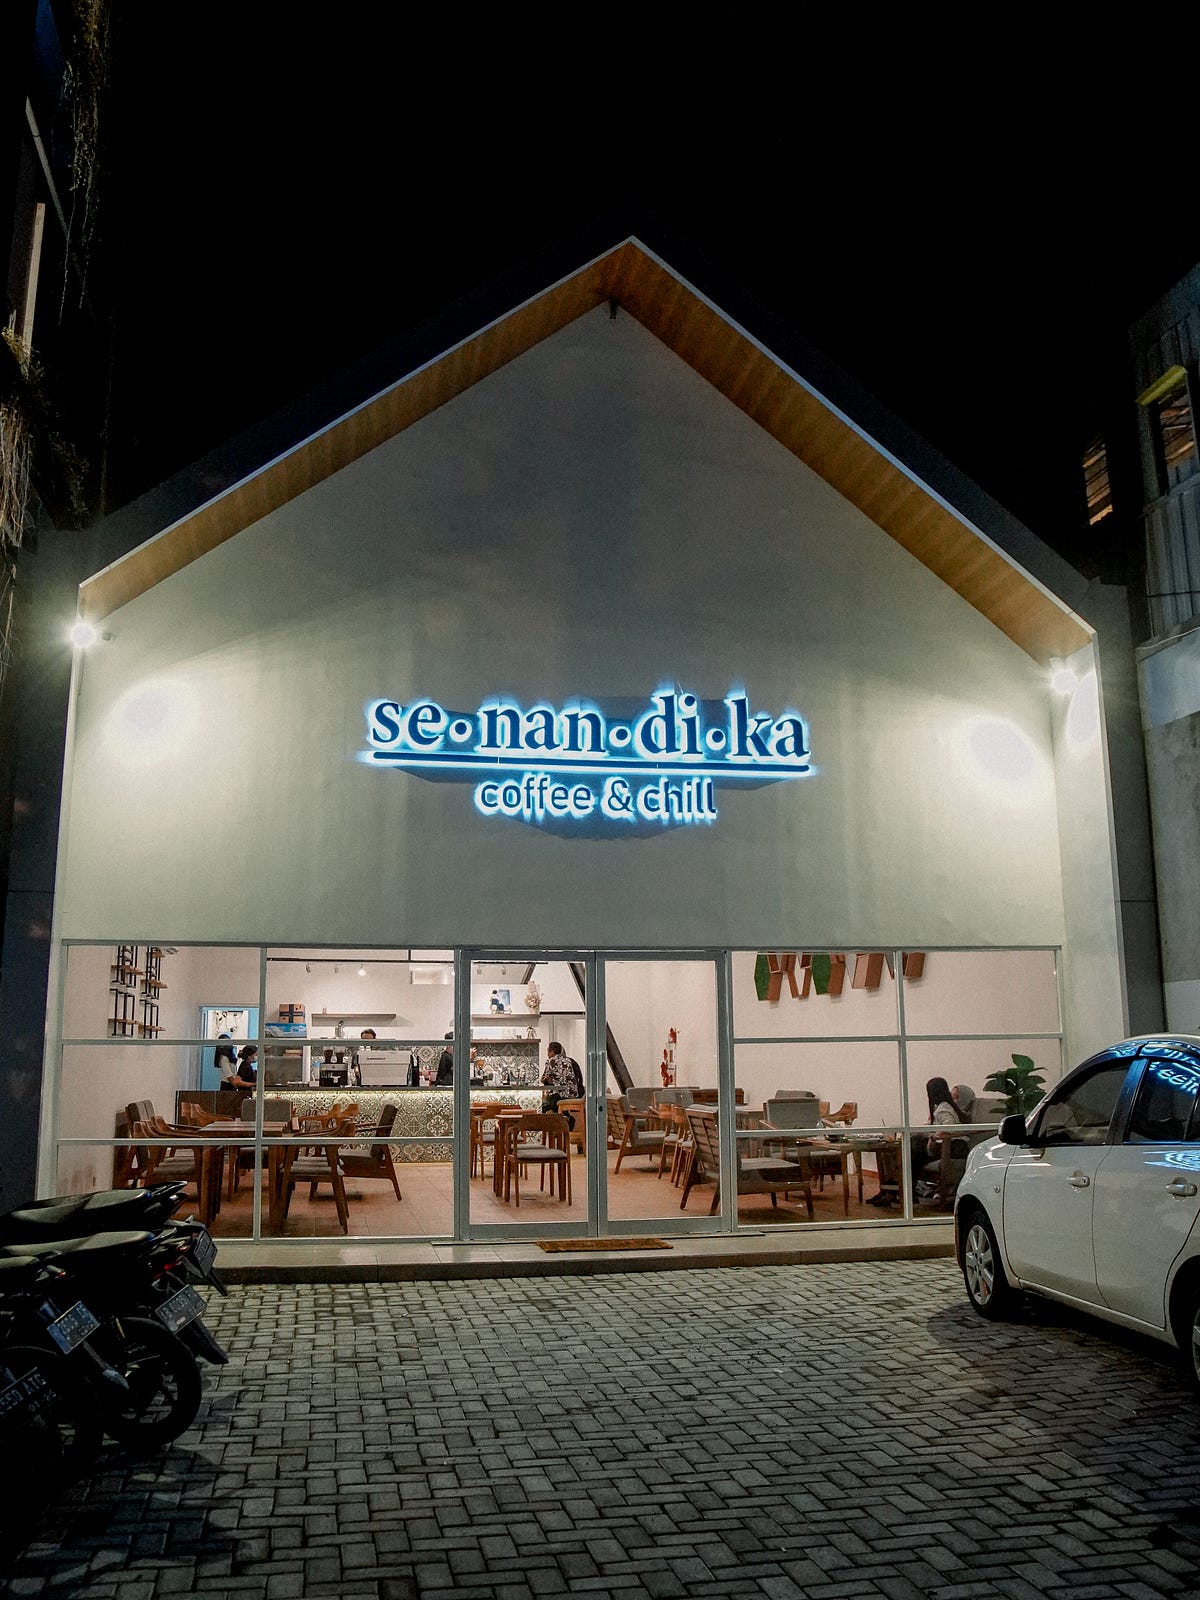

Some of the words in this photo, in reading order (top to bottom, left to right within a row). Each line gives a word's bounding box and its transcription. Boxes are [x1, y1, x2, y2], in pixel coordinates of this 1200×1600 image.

[480, 776, 593, 811] coffee
[607, 779, 633, 813] &
[643, 781, 717, 815] chill
